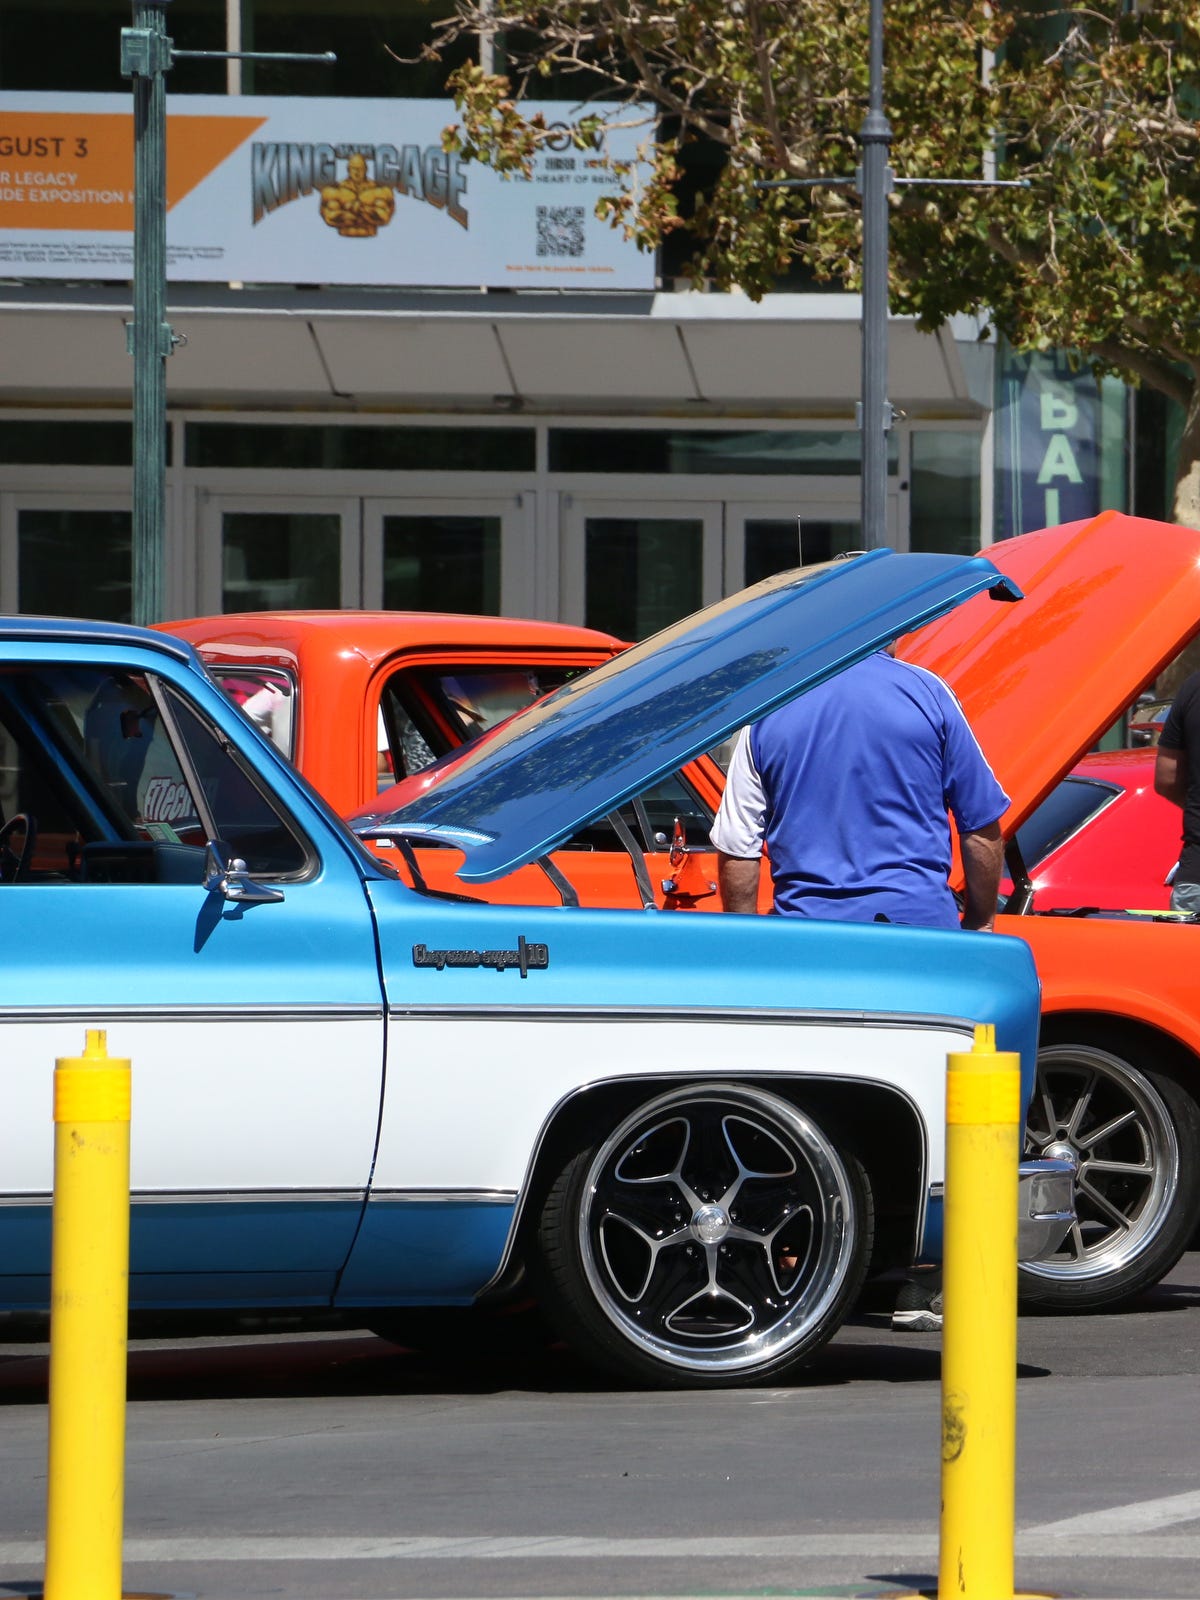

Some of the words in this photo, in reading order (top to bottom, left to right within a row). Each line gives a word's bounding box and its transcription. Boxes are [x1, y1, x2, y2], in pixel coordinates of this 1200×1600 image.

[74, 138, 88, 158] 3
[15, 173, 78, 186] LEGACY
[252, 142, 336, 226] KING
[374, 144, 468, 231] CAGE
[29, 189, 125, 203] EXPOSITION
[525, 944, 549, 969] 10
